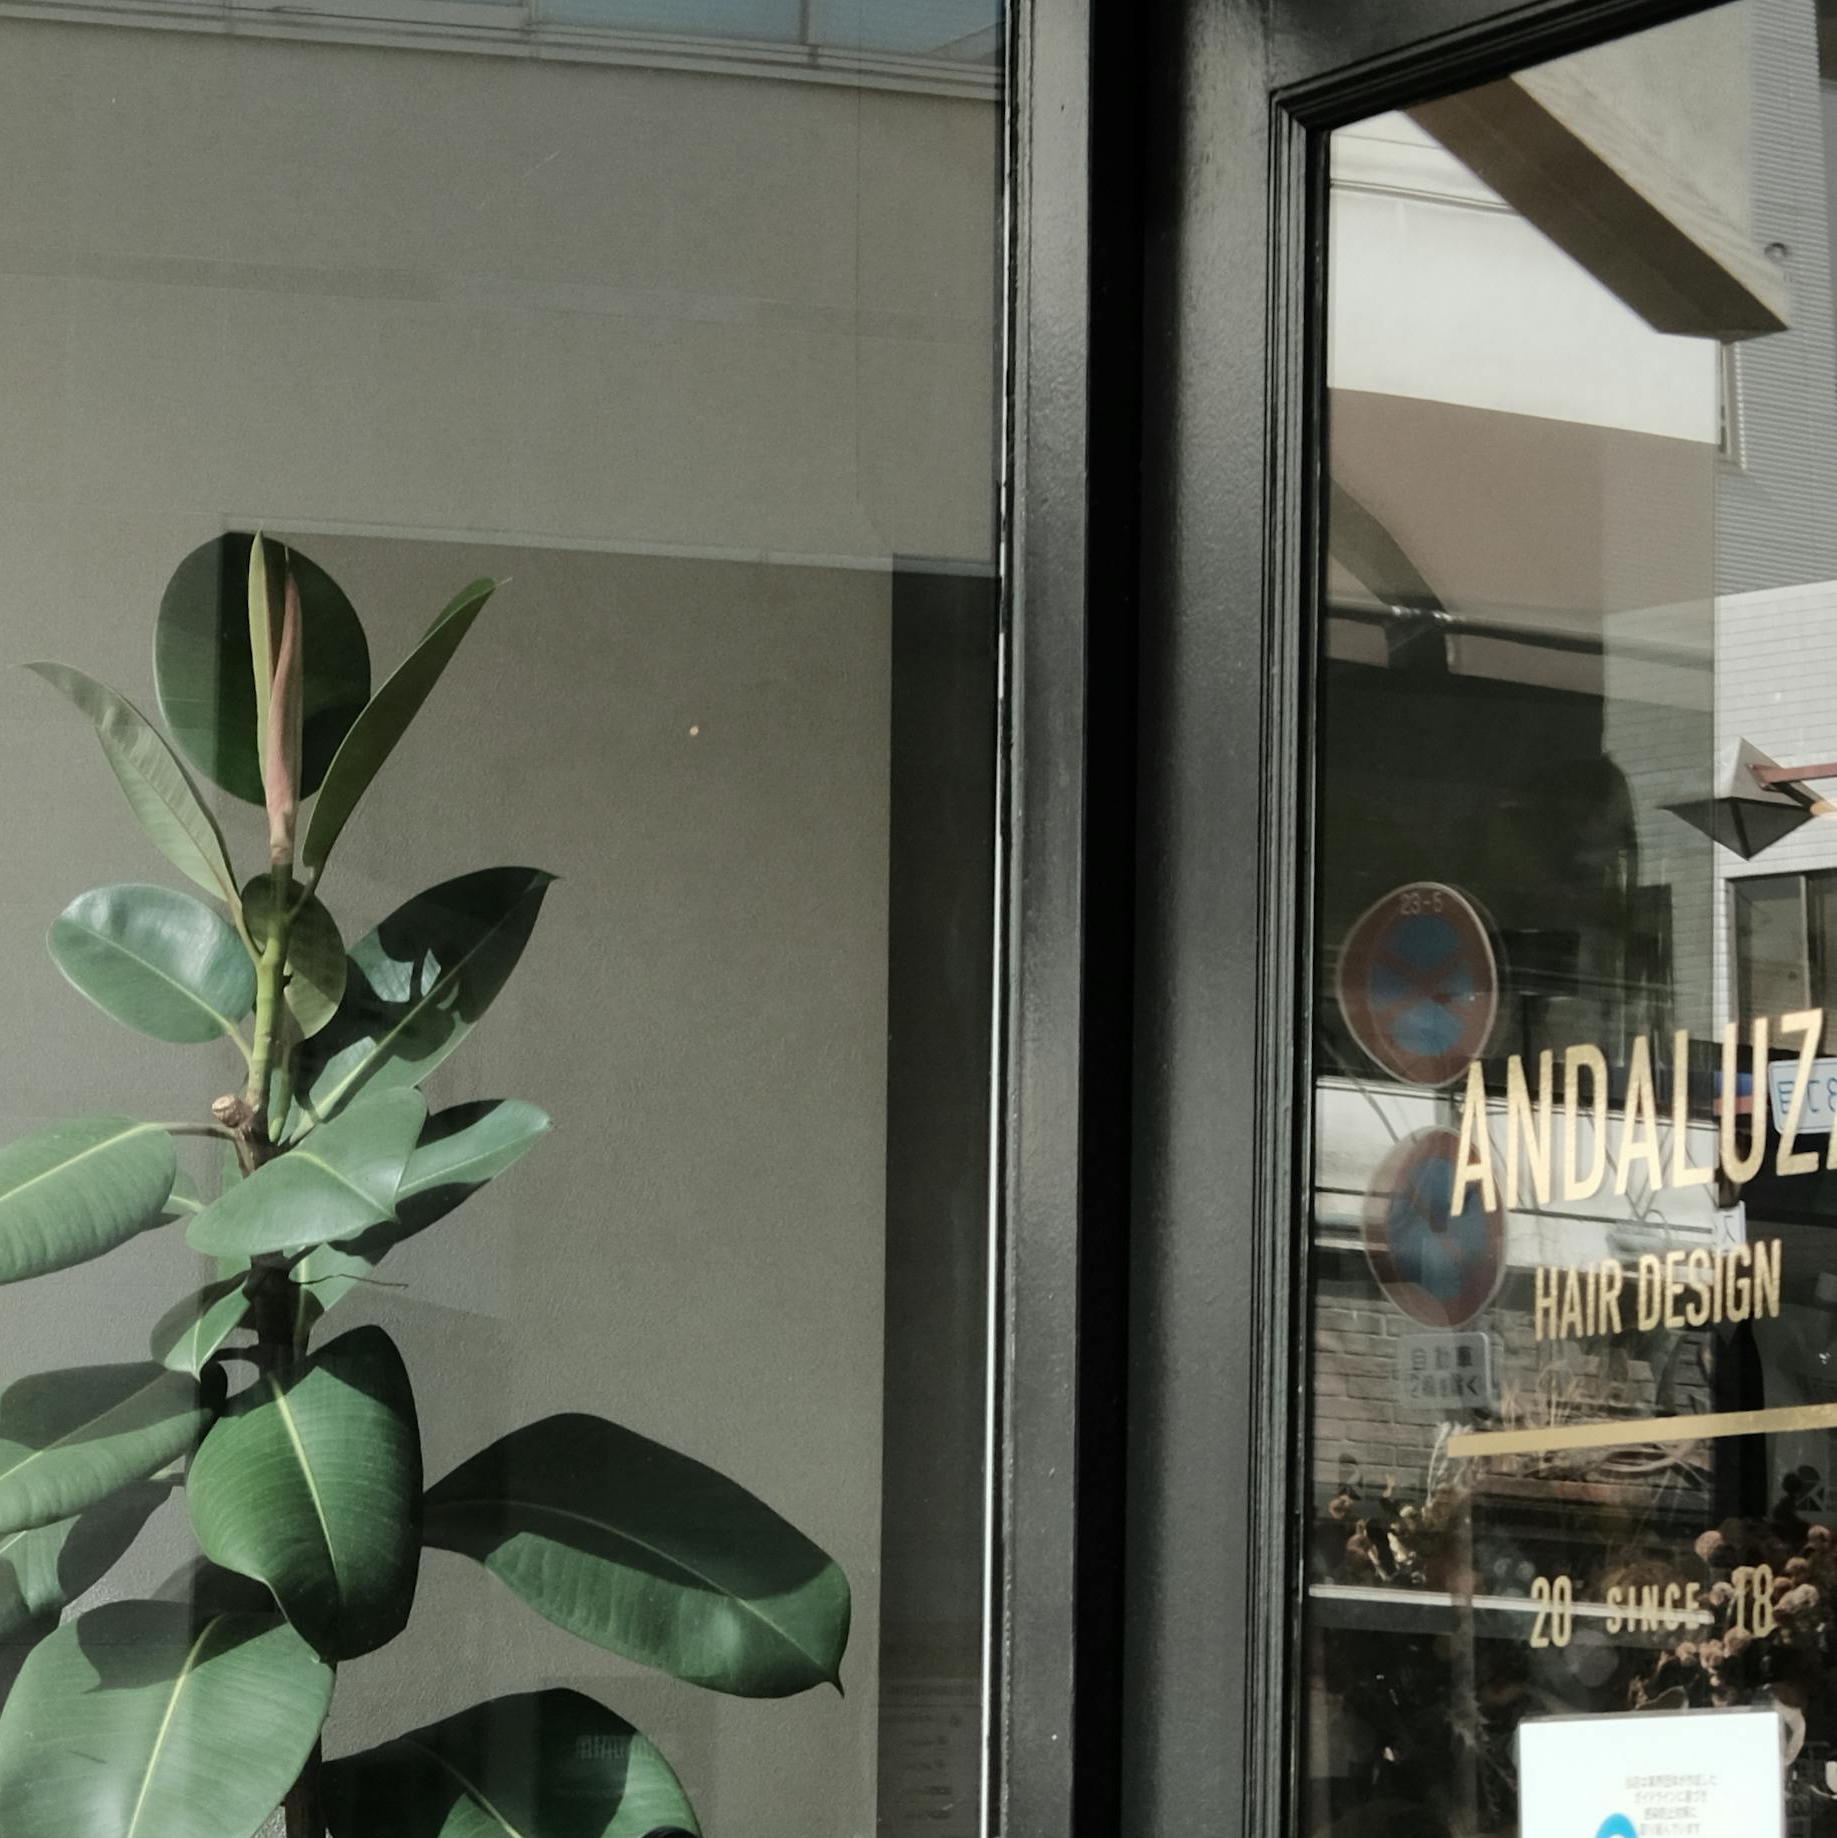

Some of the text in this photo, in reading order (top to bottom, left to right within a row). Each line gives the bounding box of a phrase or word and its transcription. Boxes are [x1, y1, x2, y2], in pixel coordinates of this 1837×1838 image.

[1450, 1008, 1837, 1217] ANDALUZ
[1535, 1239, 1782, 1342] HAIR DESIGN
[1530, 1575, 1573, 1648] 20
[1606, 1582, 1701, 1634] SINCE
